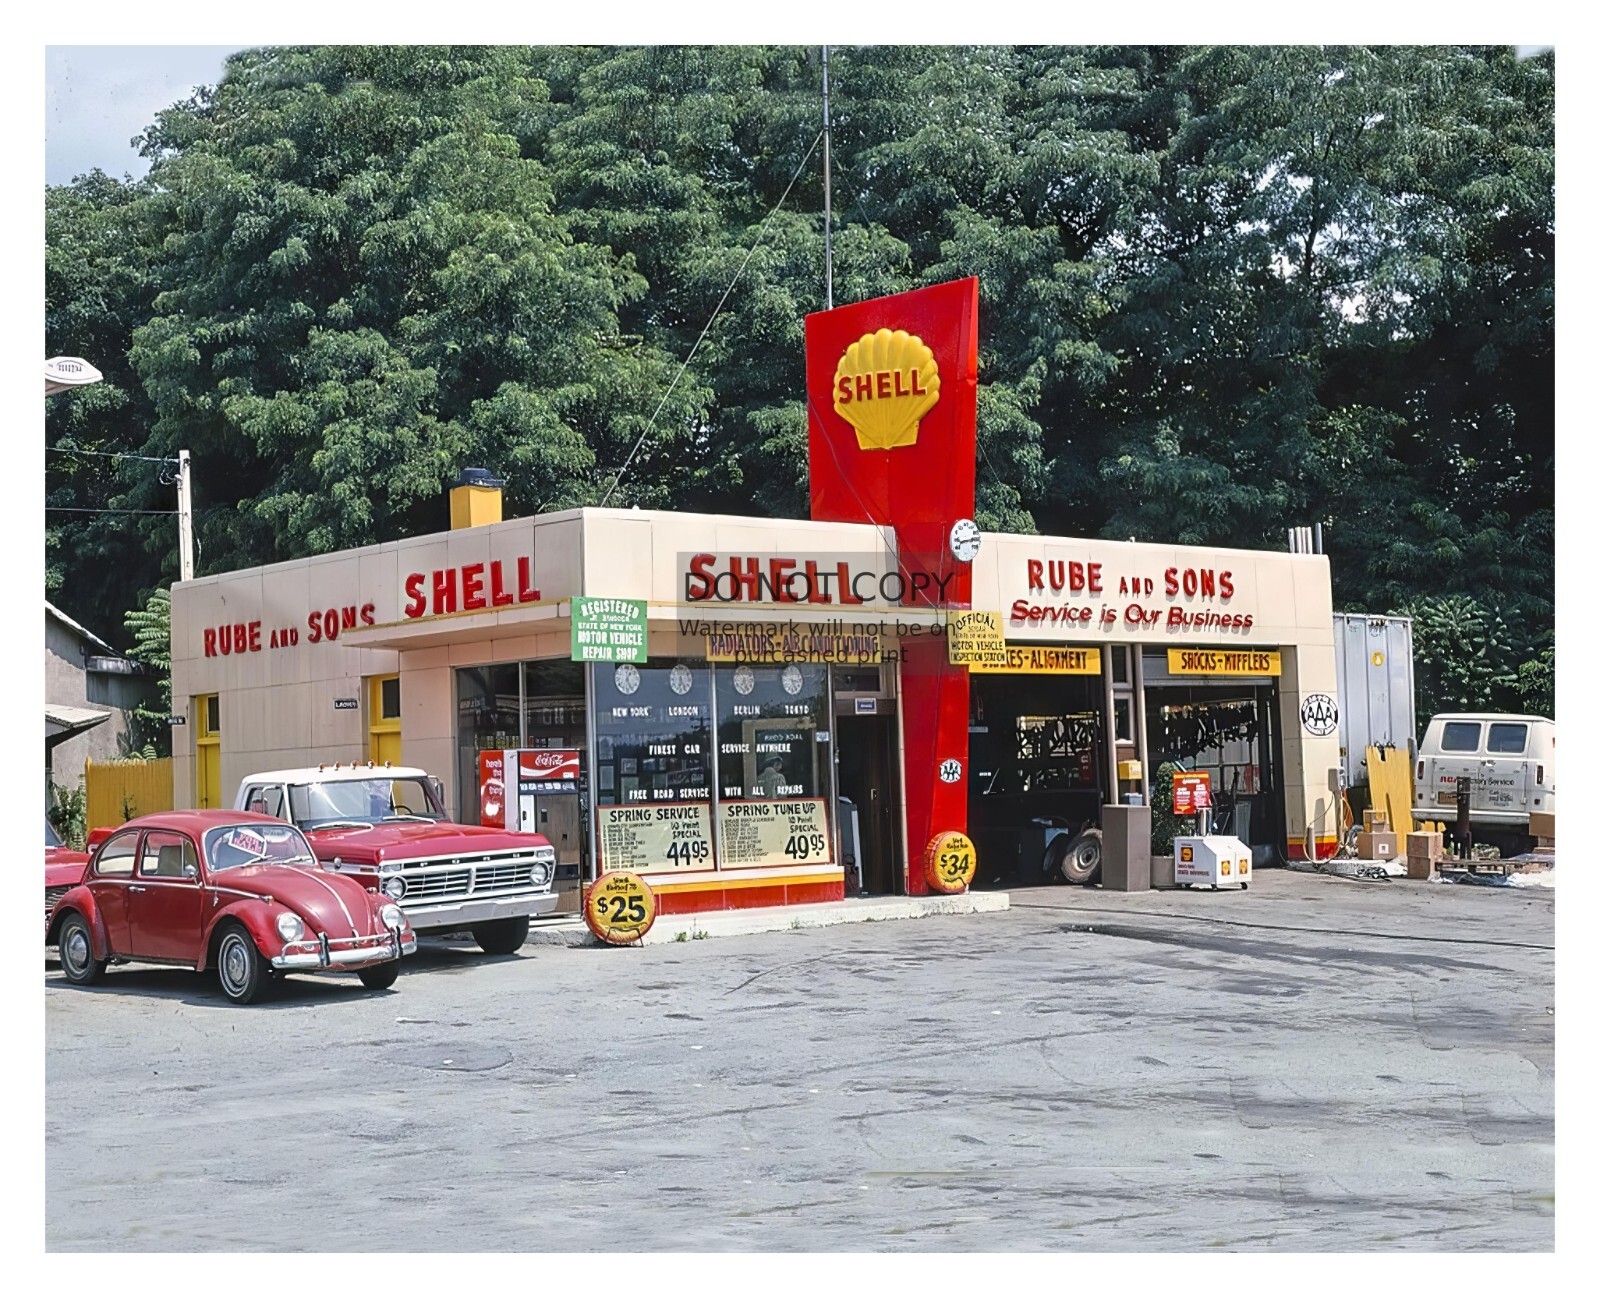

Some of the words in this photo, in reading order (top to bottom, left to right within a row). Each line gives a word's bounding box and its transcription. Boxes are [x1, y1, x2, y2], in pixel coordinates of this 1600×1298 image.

[838, 368, 927, 405] SHELL
[689, 553, 864, 605] SHELL
[1027, 558, 1104, 592] RUBE
[1119, 576, 1154, 595] AND
[1164, 567, 1235, 599] SONS
[404, 556, 541, 618] SHELL
[580, 599, 640, 619] REGISTERED
[1011, 599, 1093, 621] Service
[1101, 603, 1117, 624] is
[1125, 603, 1163, 625] Our
[1166, 606, 1254, 628] Business
[955, 612, 996, 631] OFFICIAL
[203, 620, 262, 658] RUBE
[269, 626, 299, 650] AND
[307, 603, 376, 644] SONS
[577, 630, 608, 645] MOTOR
[609, 631, 643, 646] VEHICLE
[582, 646, 612, 660] REPAIR
[616, 647, 638, 660] SHOP
[951, 640, 974, 651] MOTOR
[976, 640, 1003, 651] VEHICLE
[612, 707, 628, 717] NEW
[630, 706, 649, 717] YORK
[668, 706, 698, 716] LONDON
[733, 705, 761, 715] BERLIN
[785, 705, 810, 714] TOKYO
[649, 744, 677, 755] FINEST
[684, 744, 700, 754] CAR
[721, 743, 750, 754] SERVICE
[756, 743, 791, 753] ANYWHERE
[629, 789, 648, 800] FREE
[653, 788, 674, 799] ROAD
[680, 787, 710, 798] SERVICE
[724, 786, 742, 797] WITH
[752, 785, 765, 796] ALL
[776, 784, 804, 795] REPAIRS
[609, 808, 652, 823] SPRING
[656, 806, 700, 821] SERVICE
[727, 804, 770, 817] SPRING
[773, 803, 801, 815] TUNE
[802, 802, 816, 814] UP
[672, 829, 702, 840] SPECIAL
[790, 824, 819, 834] SPECIAL
[940, 853, 970, 876] $34
[596, 894, 646, 923] $25
